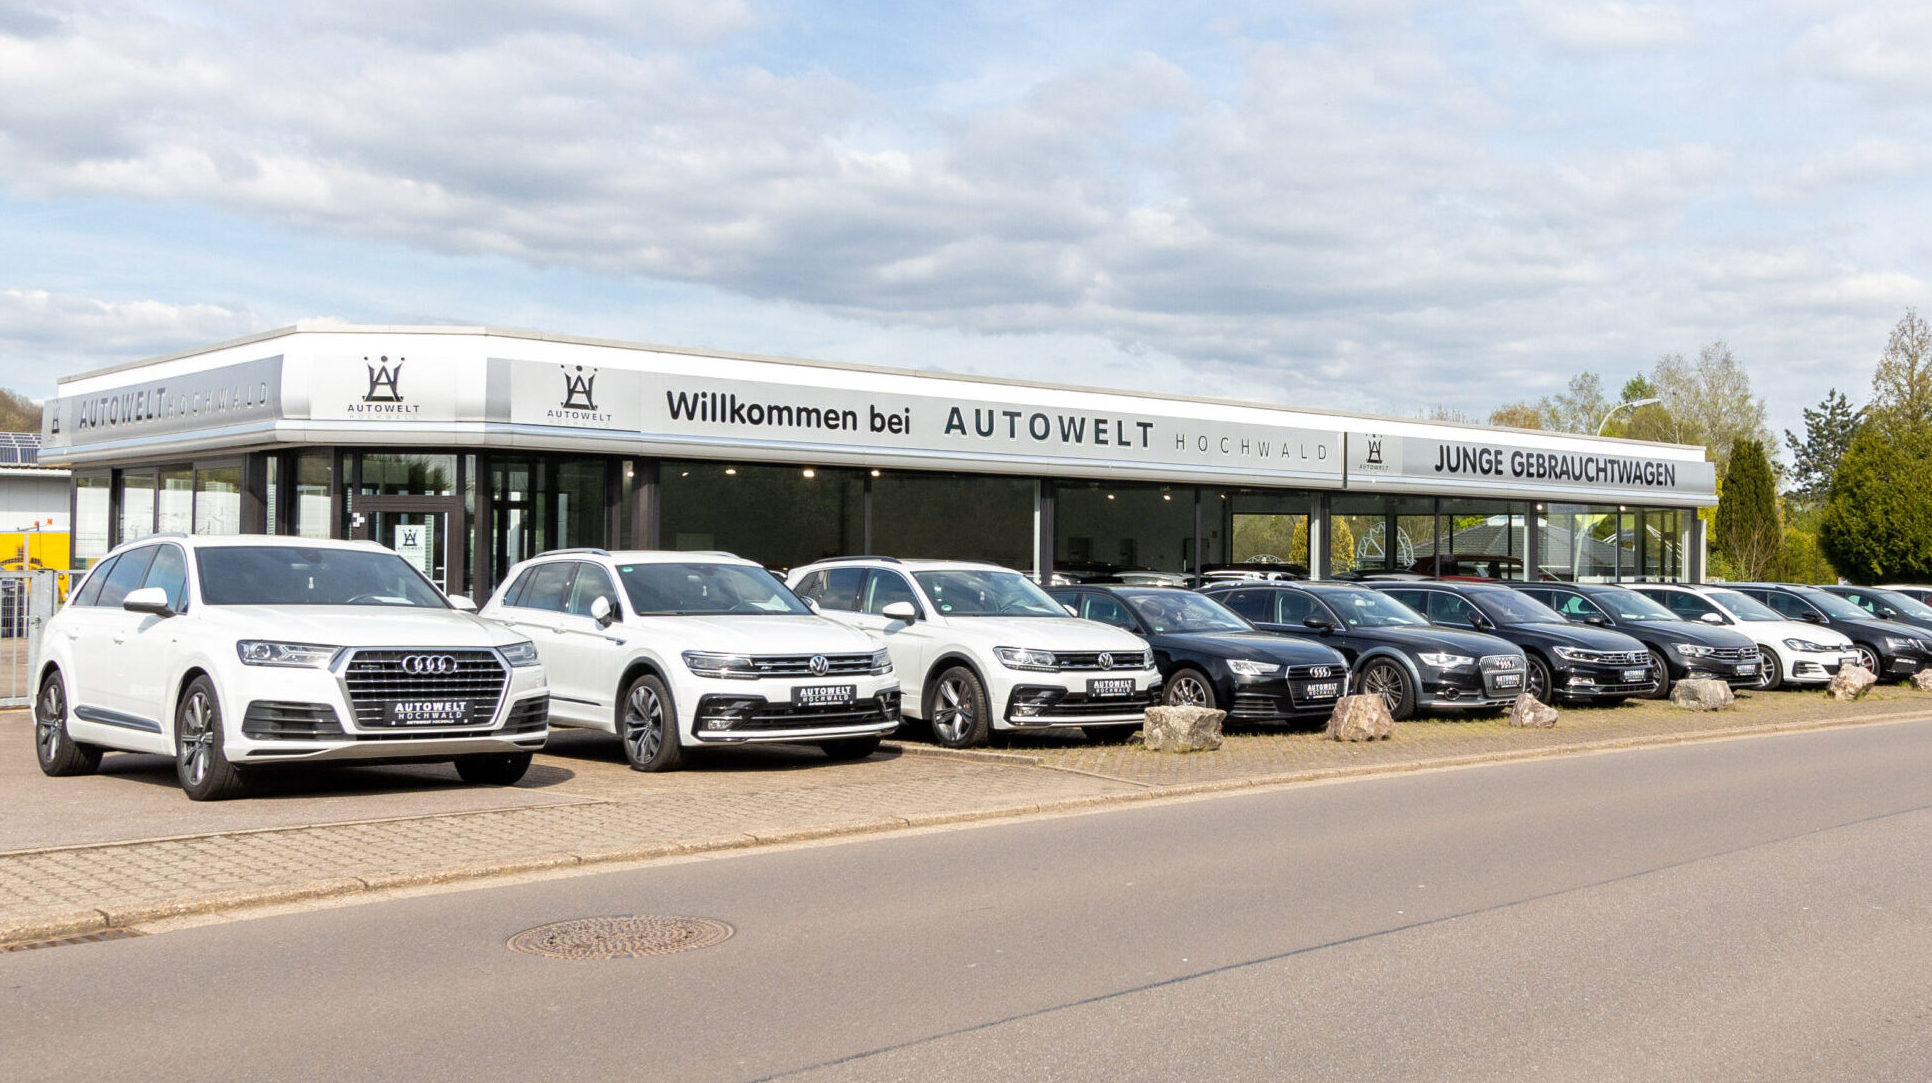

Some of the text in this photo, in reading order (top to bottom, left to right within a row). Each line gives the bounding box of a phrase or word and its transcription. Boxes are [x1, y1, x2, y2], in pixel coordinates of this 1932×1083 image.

[80, 381, 268, 429] AUTOWELT HOCHWALD
[347, 404, 420, 413] AUTOWELT
[547, 409, 612, 422] AUTOWELT
[666, 390, 1329, 461] Willkommen bei AUTOWELT HOCHWALD
[1434, 444, 1676, 487] JUNGE GEBRAUCHTWAGEN
[1093, 680, 1132, 688] AUTOWELT
[800, 686, 851, 696] AUTOWELT
[802, 694, 849, 702] HOCHWALD
[394, 701, 467, 712] AUTOWELT
[398, 711, 462, 720] HOCHWALD
